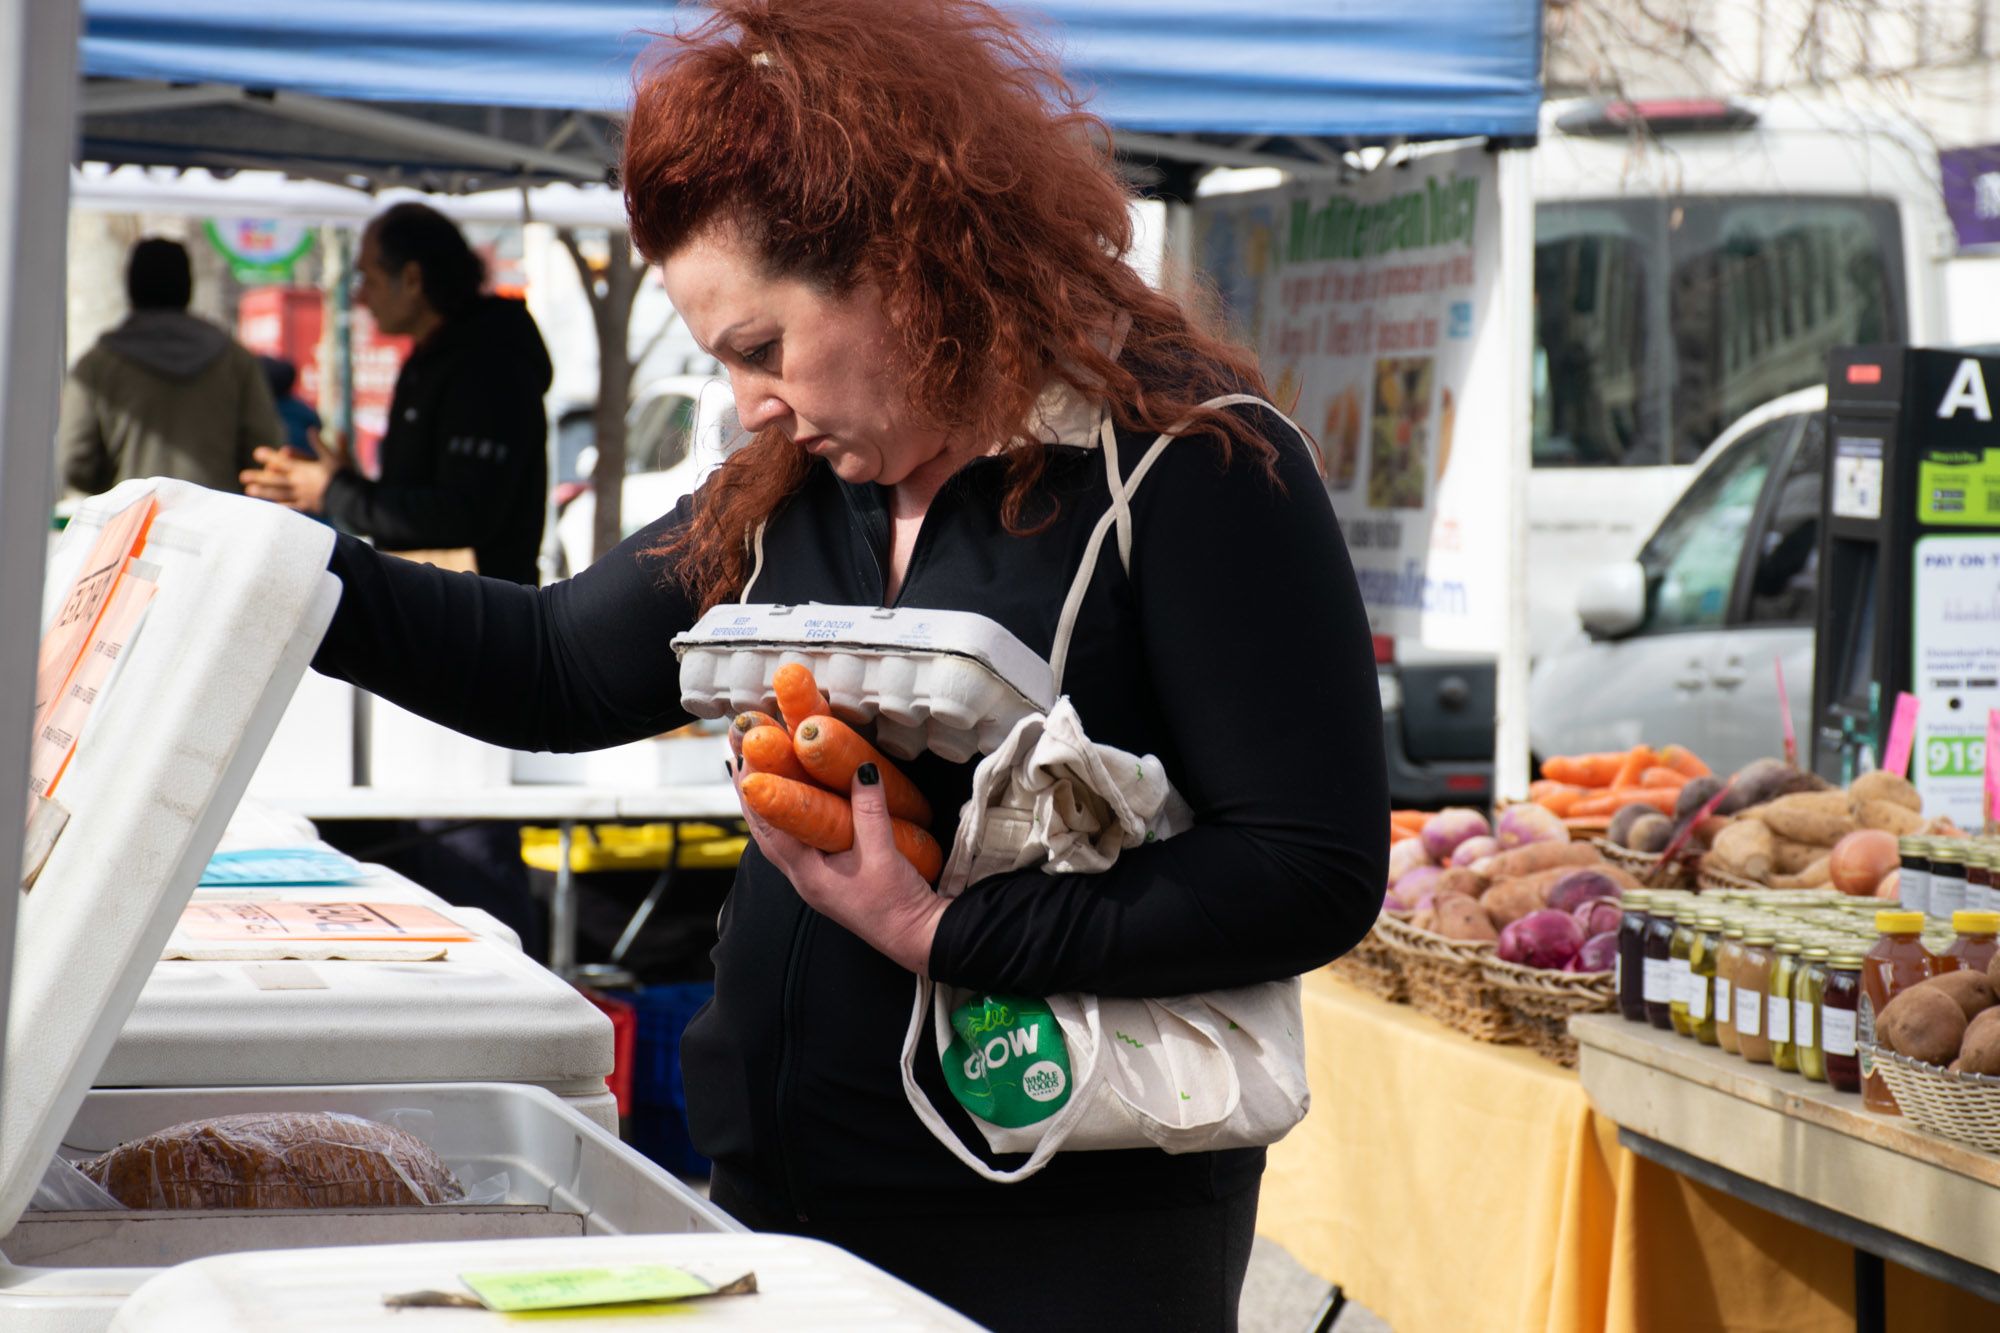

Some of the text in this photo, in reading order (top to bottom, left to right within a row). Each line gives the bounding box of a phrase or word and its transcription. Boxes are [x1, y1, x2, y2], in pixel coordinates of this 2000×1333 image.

[1936, 358, 1993, 421] A
[1925, 554, 1953, 568] PAY
[804, 619, 855, 629] ONE DOZEN
[806, 629, 838, 638] EGGS
[1929, 741, 1985, 773] 919
[1023, 1070, 1059, 1086] WHOLE
[1027, 1081, 1060, 1093] FOODS
